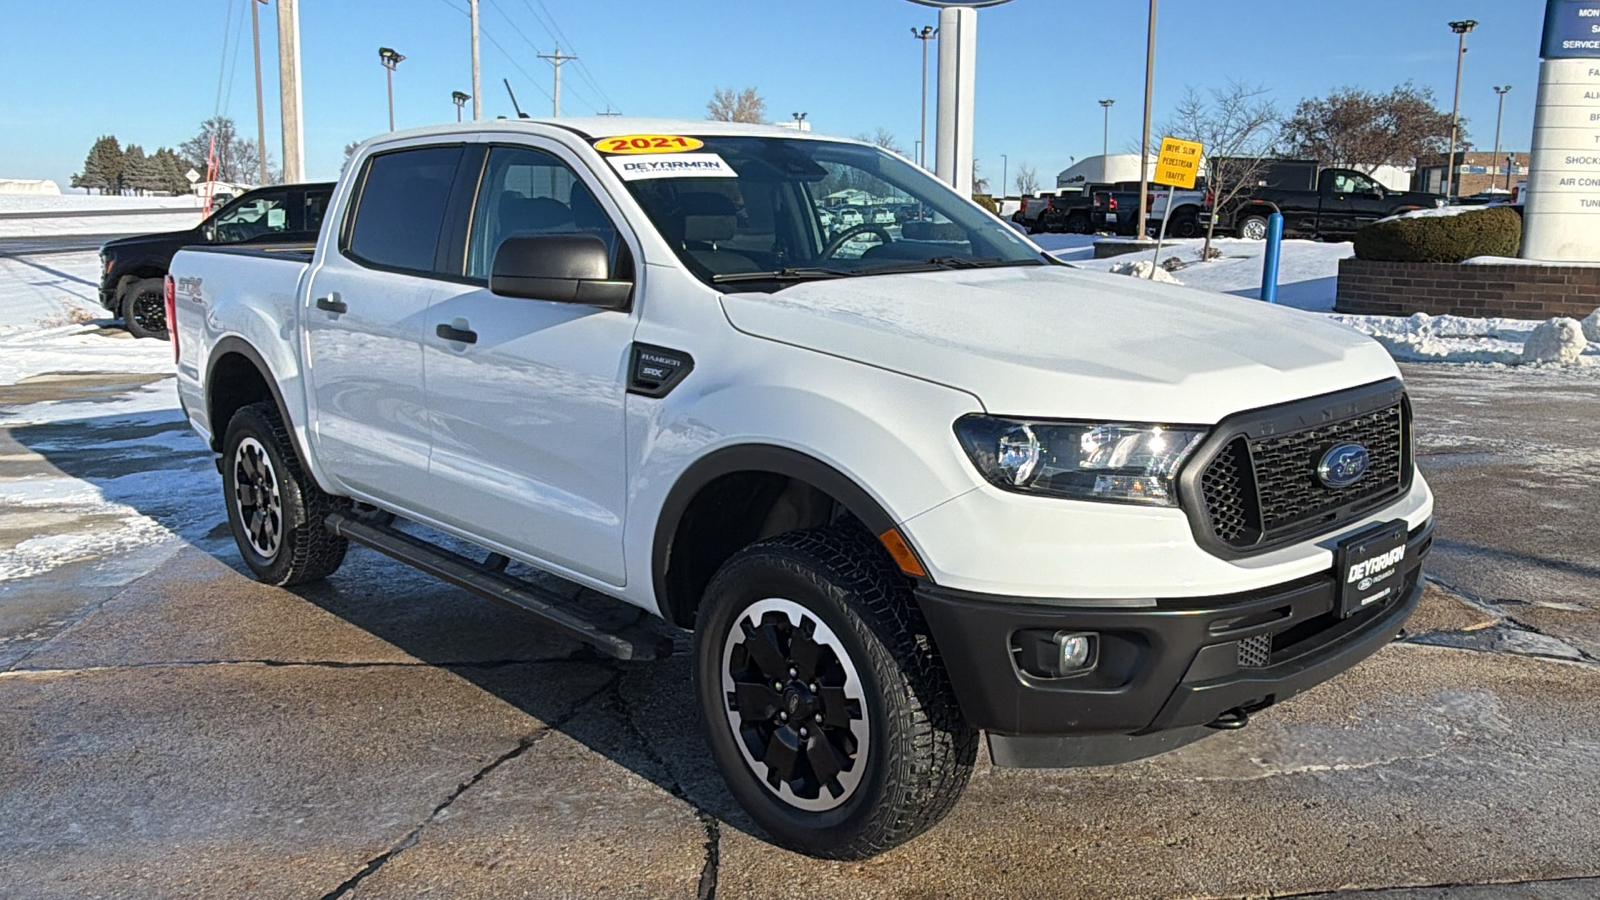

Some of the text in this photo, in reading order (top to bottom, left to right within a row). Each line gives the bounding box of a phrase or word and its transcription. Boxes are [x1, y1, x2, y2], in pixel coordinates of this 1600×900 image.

[1562, 40, 1600, 49] SERVICE
[609, 137, 689, 151] 2021
[1165, 144, 1196, 155] DRIVE SLOW
[1162, 156, 1193, 169] PEDESTRIAN
[1565, 156, 1600, 164] SHOCK
[623, 161, 720, 171] DEYARMAN
[1165, 171, 1187, 181] TRAFFIC
[1559, 178, 1576, 186] AIR
[641, 353, 681, 367] RANGER
[1347, 544, 1406, 583] DEYARMAN
